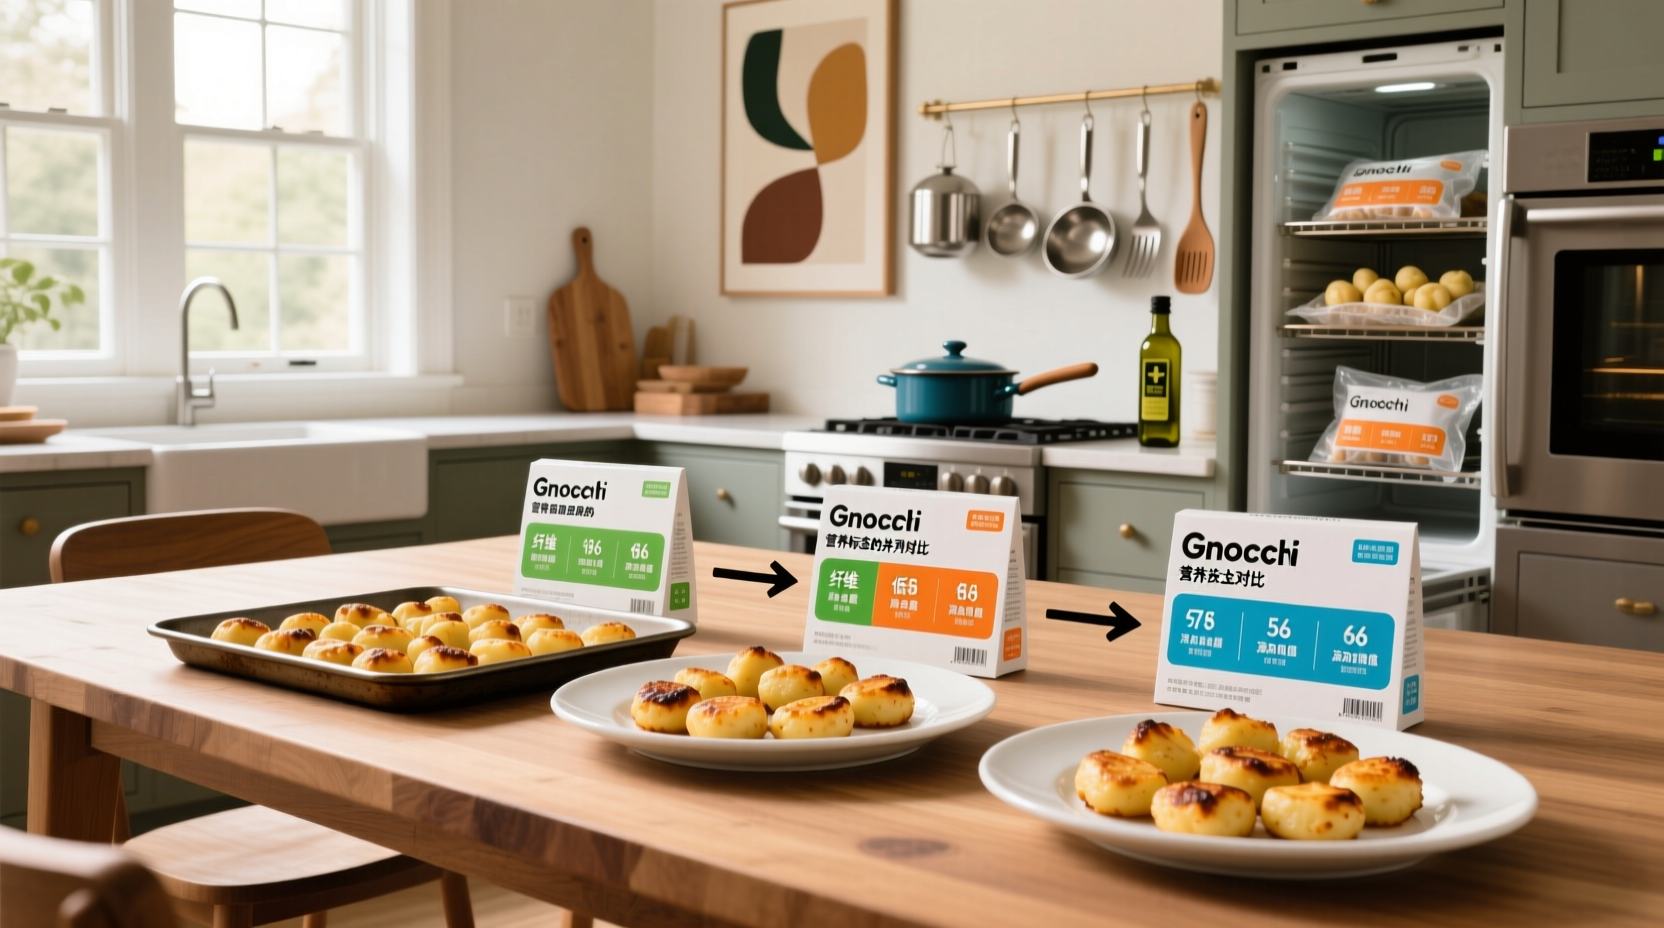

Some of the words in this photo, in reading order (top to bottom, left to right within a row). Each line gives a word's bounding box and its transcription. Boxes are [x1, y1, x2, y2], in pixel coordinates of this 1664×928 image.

[1181, 531, 1300, 567] Gnocchi
[828, 569, 859, 590] 纤维
[1266, 616, 1292, 639] 56
[1342, 624, 1368, 647] 66
